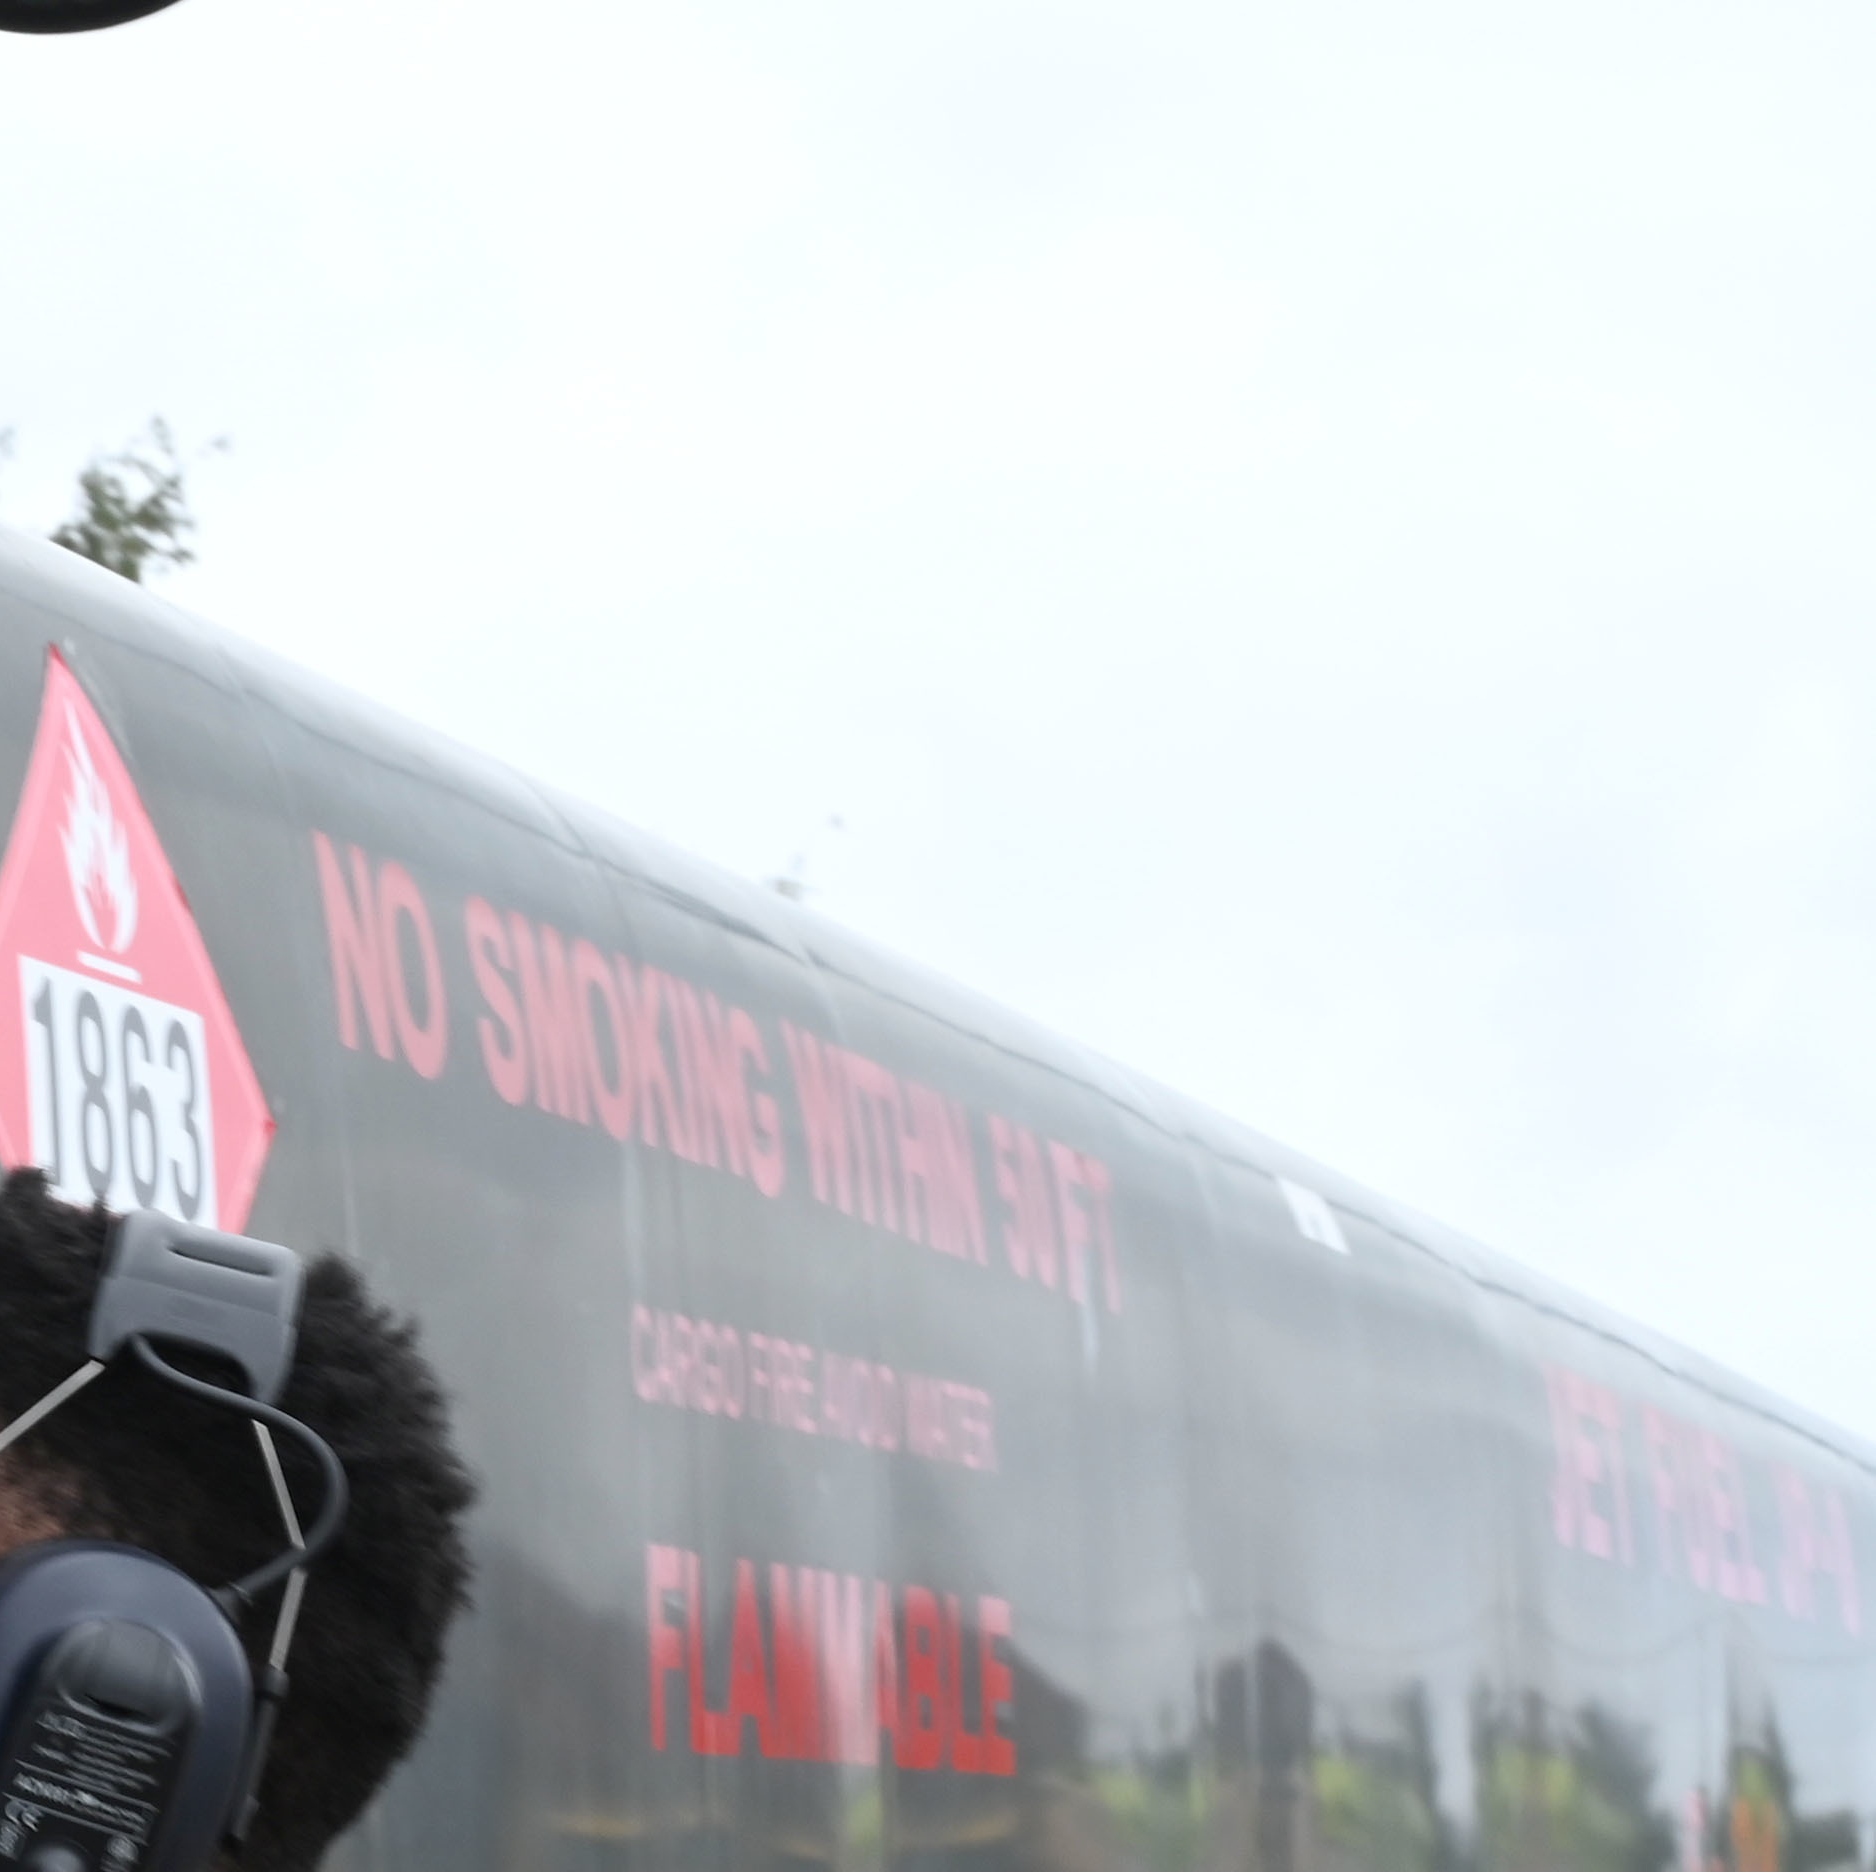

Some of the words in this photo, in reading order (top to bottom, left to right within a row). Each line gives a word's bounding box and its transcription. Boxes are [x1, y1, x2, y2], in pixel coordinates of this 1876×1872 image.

[31, 975, 204, 1221] 1863
[310, 828, 446, 1081] NO
[464, 892, 786, 1199] SMOKING
[781, 1016, 988, 1267] WITHIN
[645, 1541, 1018, 1777] FLAMMABLE
